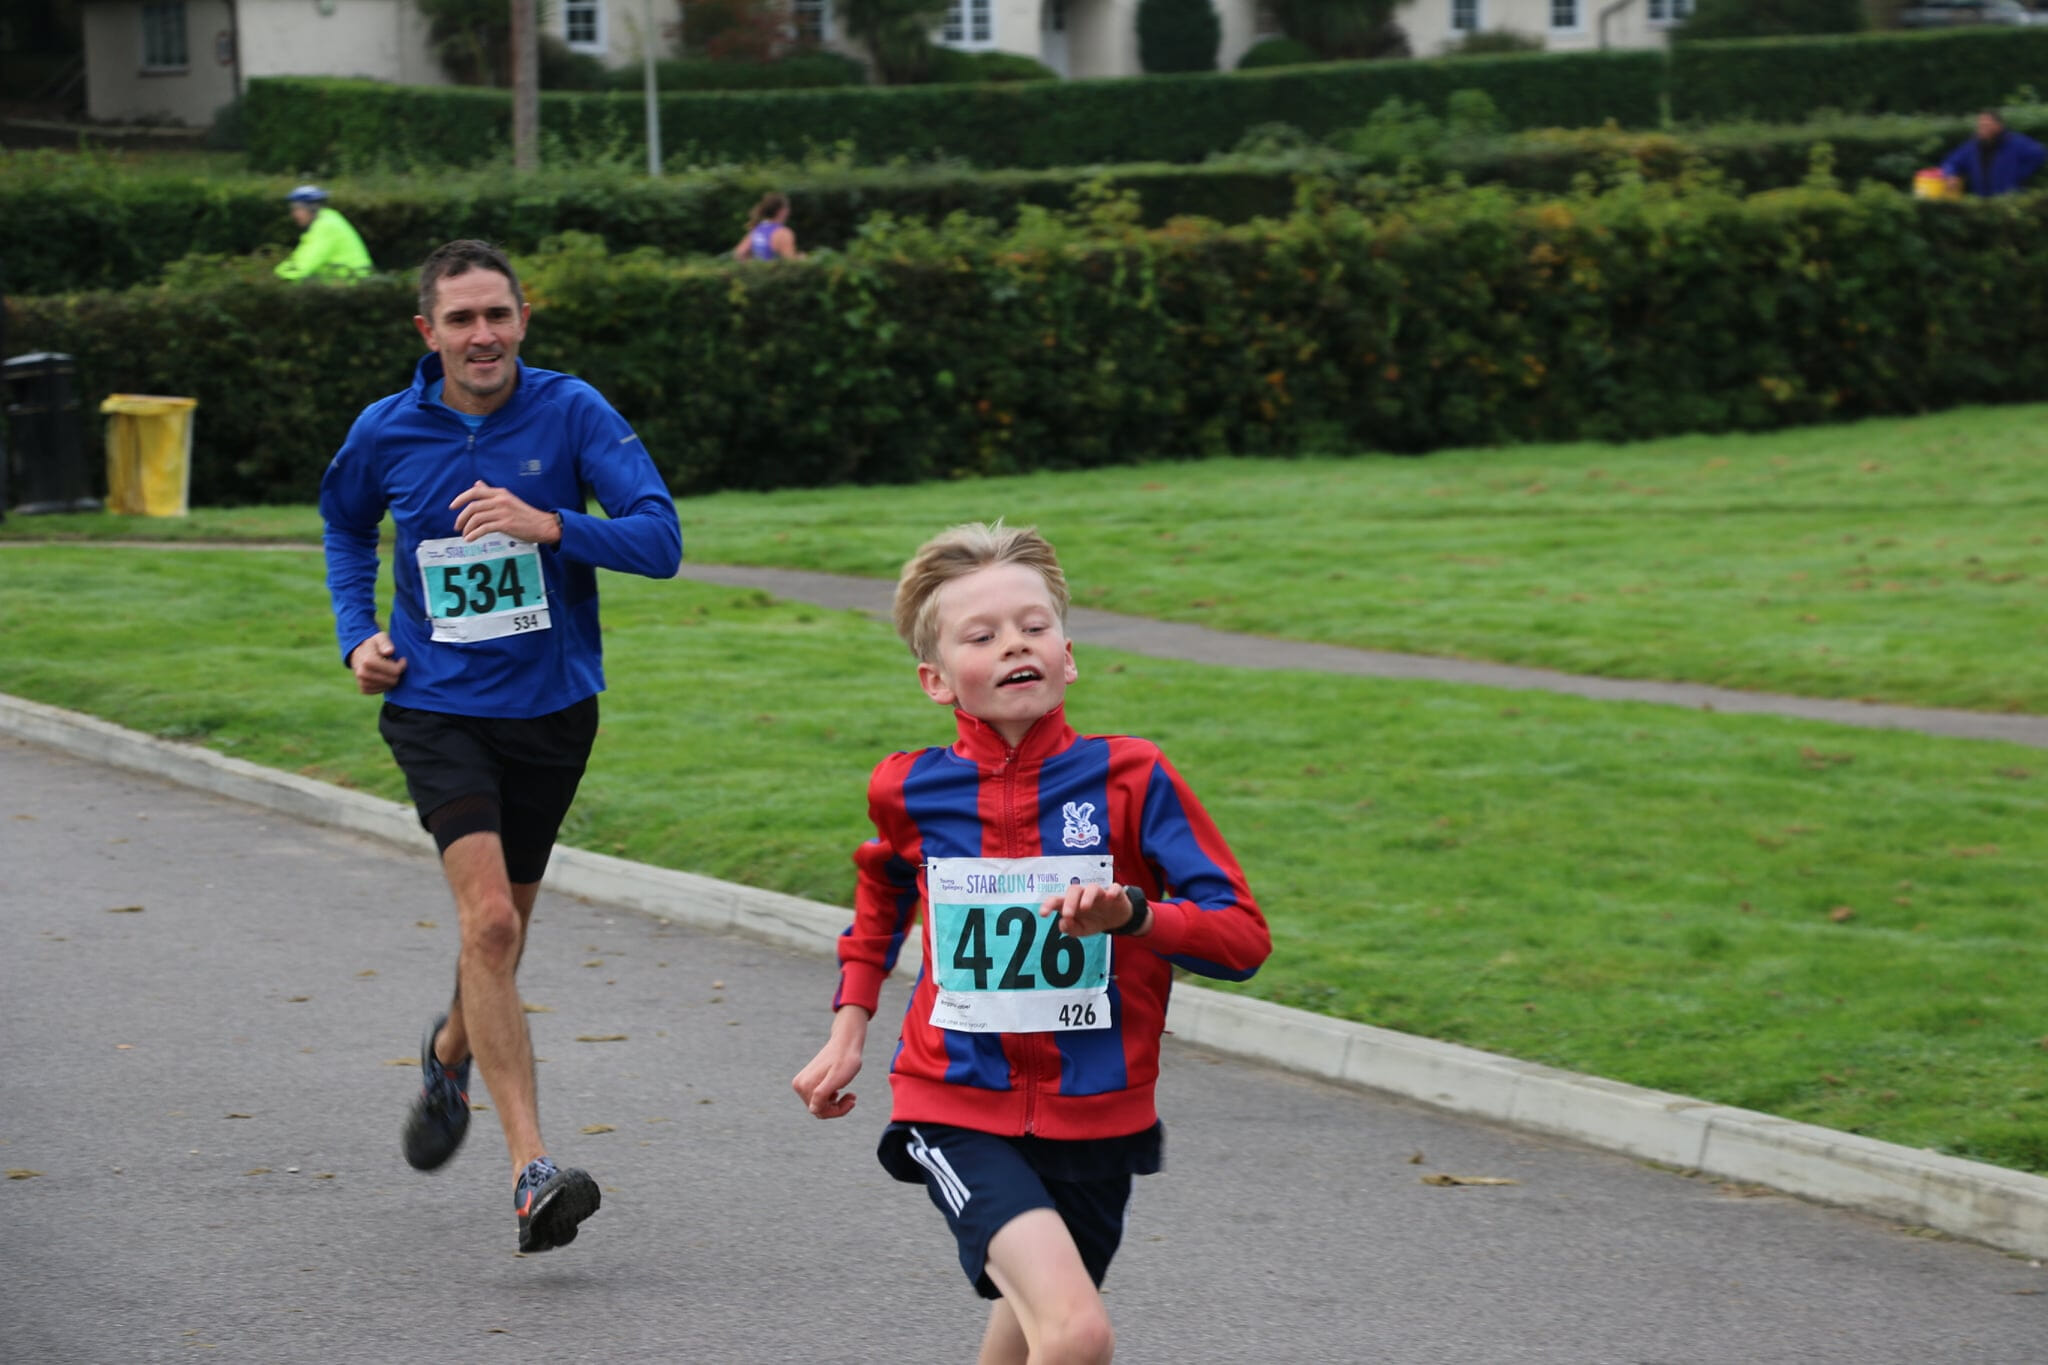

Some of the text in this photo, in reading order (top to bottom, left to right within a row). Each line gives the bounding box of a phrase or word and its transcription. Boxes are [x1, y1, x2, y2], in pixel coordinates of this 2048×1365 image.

[444, 558, 525, 617] 534
[514, 614, 538, 631] 534
[1037, 873, 1059, 882] YOUNG
[953, 906, 1085, 990] 426
[1059, 1003, 1096, 1027] 426
